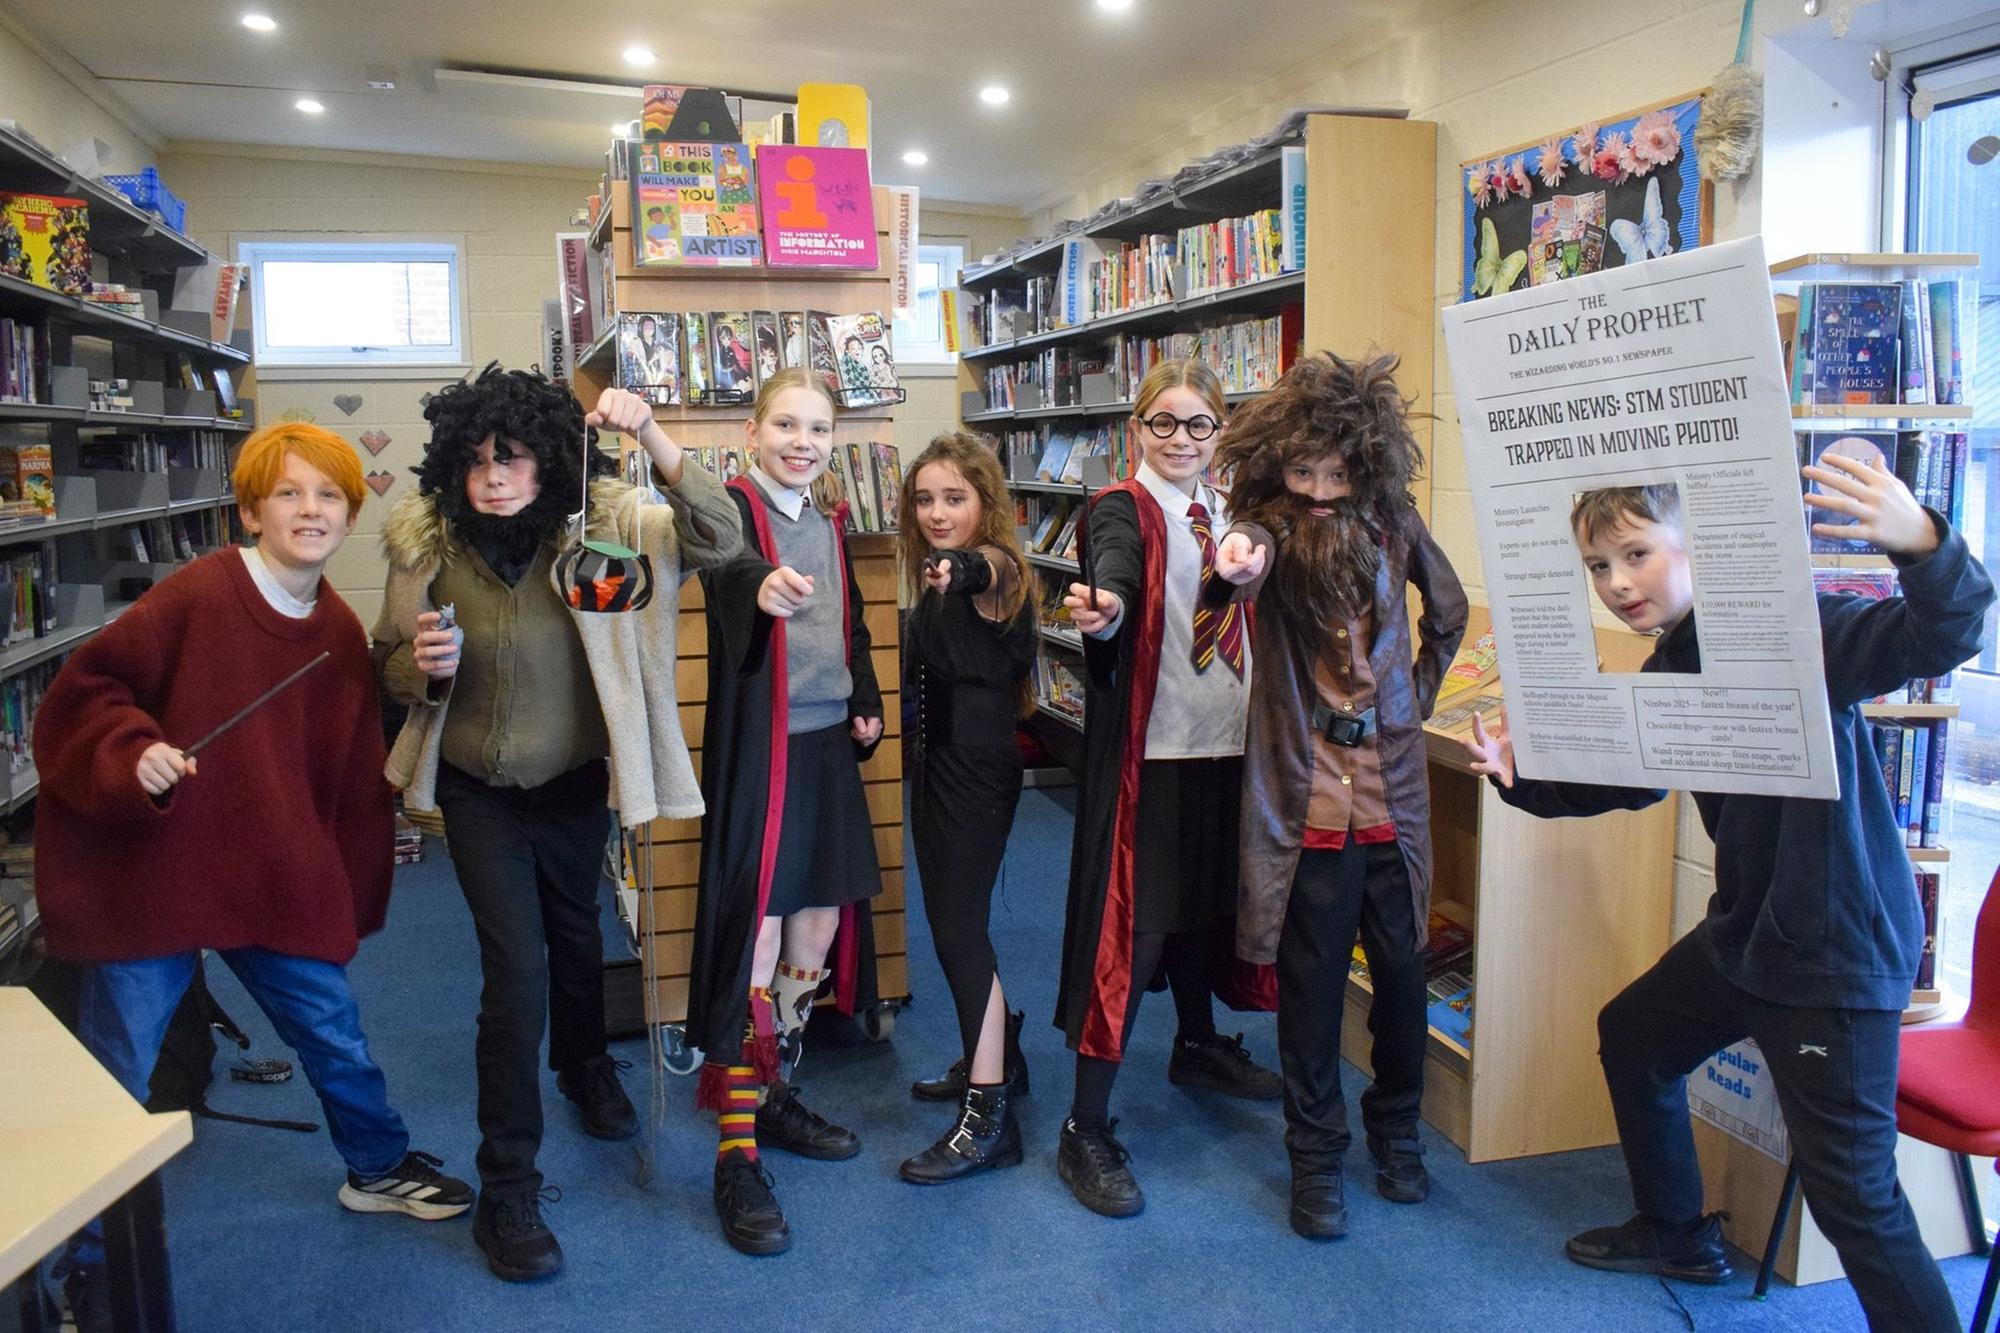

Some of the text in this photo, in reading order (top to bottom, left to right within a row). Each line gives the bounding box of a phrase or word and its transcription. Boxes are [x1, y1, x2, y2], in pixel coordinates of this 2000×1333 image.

[679, 146, 712, 158] THIS
[662, 161, 713, 174] BOOK
[640, 177, 699, 186] WILL MAKE
[680, 189, 715, 202] YOU
[720, 205, 735, 213] AN
[1292, 184, 1306, 269] HUMOUR
[687, 238, 757, 256] ARTIST
[780, 238, 865, 250] INFORMATION
[897, 193, 910, 310] HISTORICAL FICTION
[565, 239, 578, 285] FICTION
[1067, 241, 1078, 324] GENERAL FICTION
[216, 266, 236, 321] FANTASY
[1578, 294, 1608, 312] THE
[1508, 297, 1707, 356] DAILY PROPHET
[1827, 328, 1860, 339] SMELL
[1831, 340, 1845, 349] OF
[551, 327, 564, 378] SPOOKY
[1818, 352, 1854, 363] OTHER
[1509, 371, 1525, 380] THE
[1524, 362, 1568, 379] WIZARDING
[1568, 356, 1602, 371] WORLD'S
[1602, 355, 1615, 365] NO.
[1622, 346, 1674, 363] NEWSPAPER
[1825, 365, 1872, 375] PEOPLE'S
[1839, 378, 1885, 389] HOUSES
[1487, 376, 1749, 433] BREAKING NEWS: STM STUDENT
[1505, 416, 1741, 466] TRAPPED IN MOVING PHOTO!
[20, 460, 52, 471] NARNIA
[1685, 468, 1754, 481] Ministry Officials left
[1493, 504, 1550, 517] Ministry Launches
[1495, 518, 1536, 529] Investigation
[1692, 530, 1766, 542] Department of magical
[1724, 541, 1736, 549] and
[1703, 552, 1714, 560] the
[1504, 569, 1575, 581] Strange magic detected
[1727, 600, 1761, 609] REWARD
[1762, 601, 1772, 609] for
[1702, 688, 1729, 697] New!!!
[1643, 699, 1672, 708] Nimbus
[1700, 700, 1725, 710] fastest
[1726, 701, 1750, 710] broom
[1750, 702, 1760, 710] of
[1774, 702, 1796, 713] year!
[1646, 721, 1684, 731] Chocolate
[1712, 724, 1729, 732] now
[1730, 724, 1748, 733] with
[1748, 724, 1773, 734] festive
[1774, 726, 1799, 735] bonus
[1710, 734, 1734, 742] cards!
[1651, 747, 1673, 756] Wand
[1673, 749, 1695, 758] repair
[1731, 751, 1750, 760] fixes
[1776, 753, 1802, 763] sparks
[1660, 757, 1796, 772] and accidental sheep transformations!
[1915, 758, 1926, 785] LAYLA
[1712, 1050, 1760, 1076] pular
[1707, 1065, 1753, 1100] Reads
